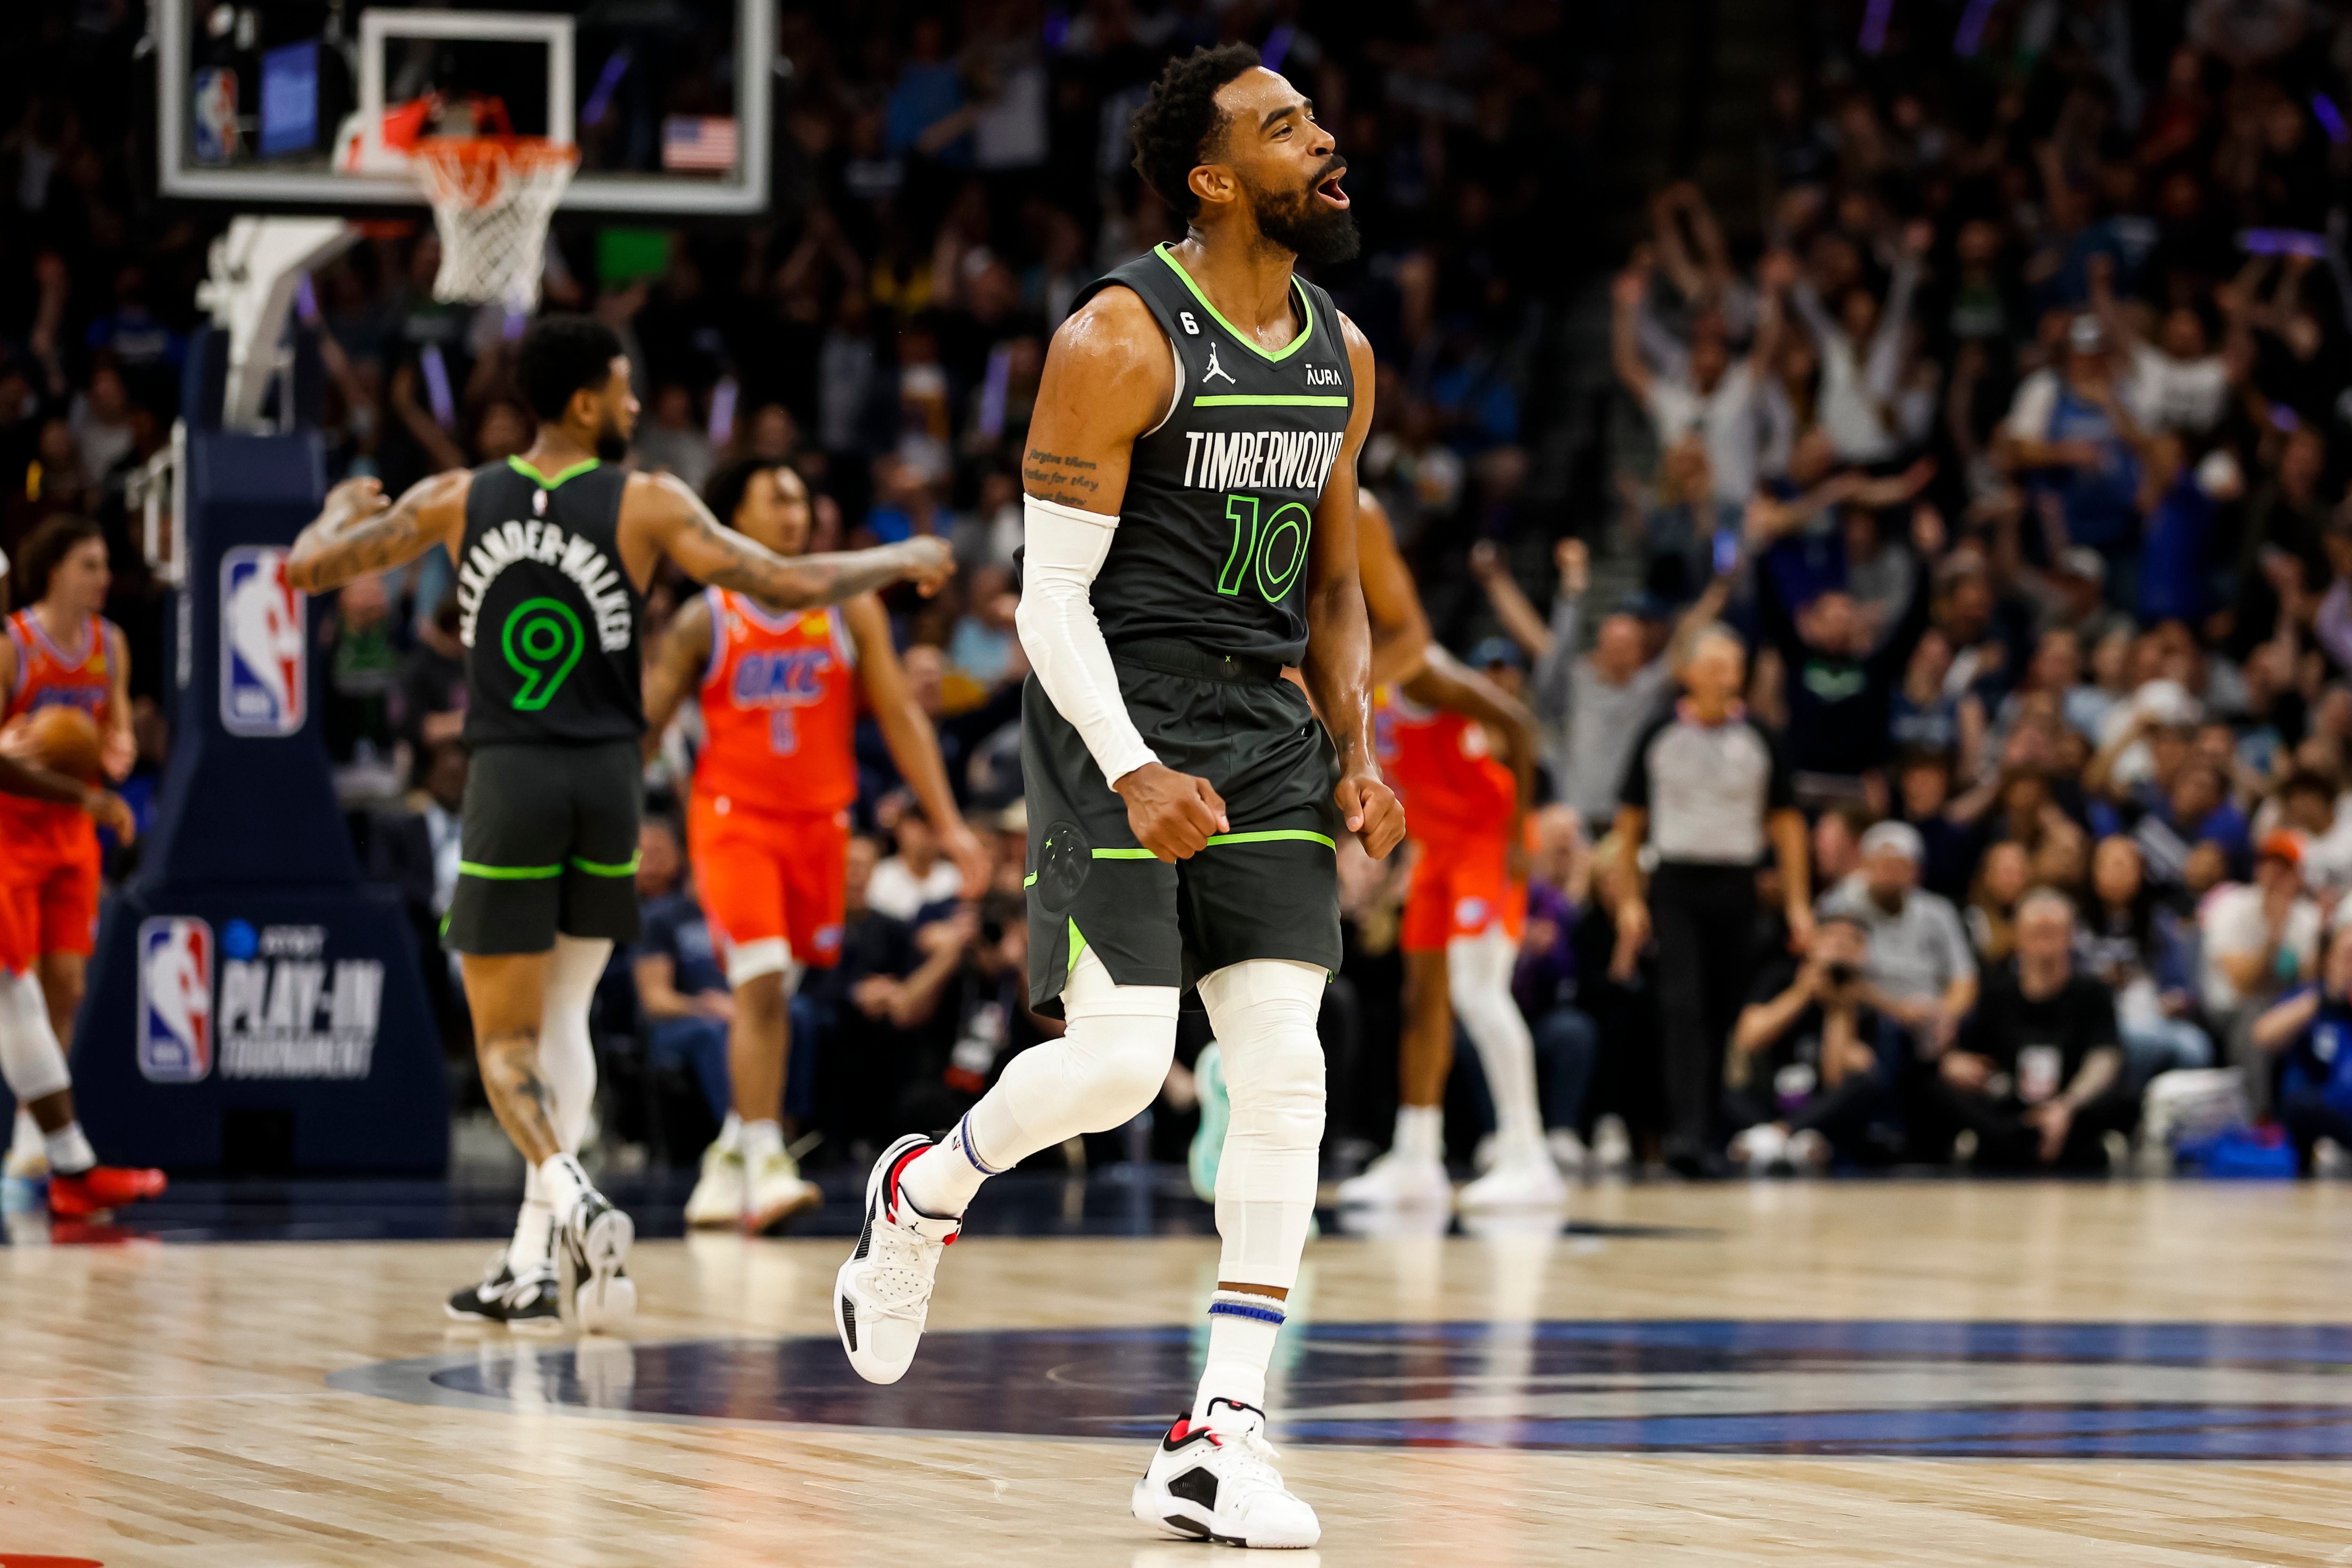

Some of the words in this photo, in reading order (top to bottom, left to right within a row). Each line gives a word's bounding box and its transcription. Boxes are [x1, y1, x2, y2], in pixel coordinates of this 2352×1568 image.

[1180, 311, 1200, 335] 6
[1184, 430, 1344, 499] TIMBERWOLVE
[1217, 494, 1311, 603] 10
[501, 596, 585, 711] 9
[732, 648, 830, 709] OKC
[218, 958, 386, 1038] PLAY-IN
[218, 1037, 375, 1081] TOURNAMENT
